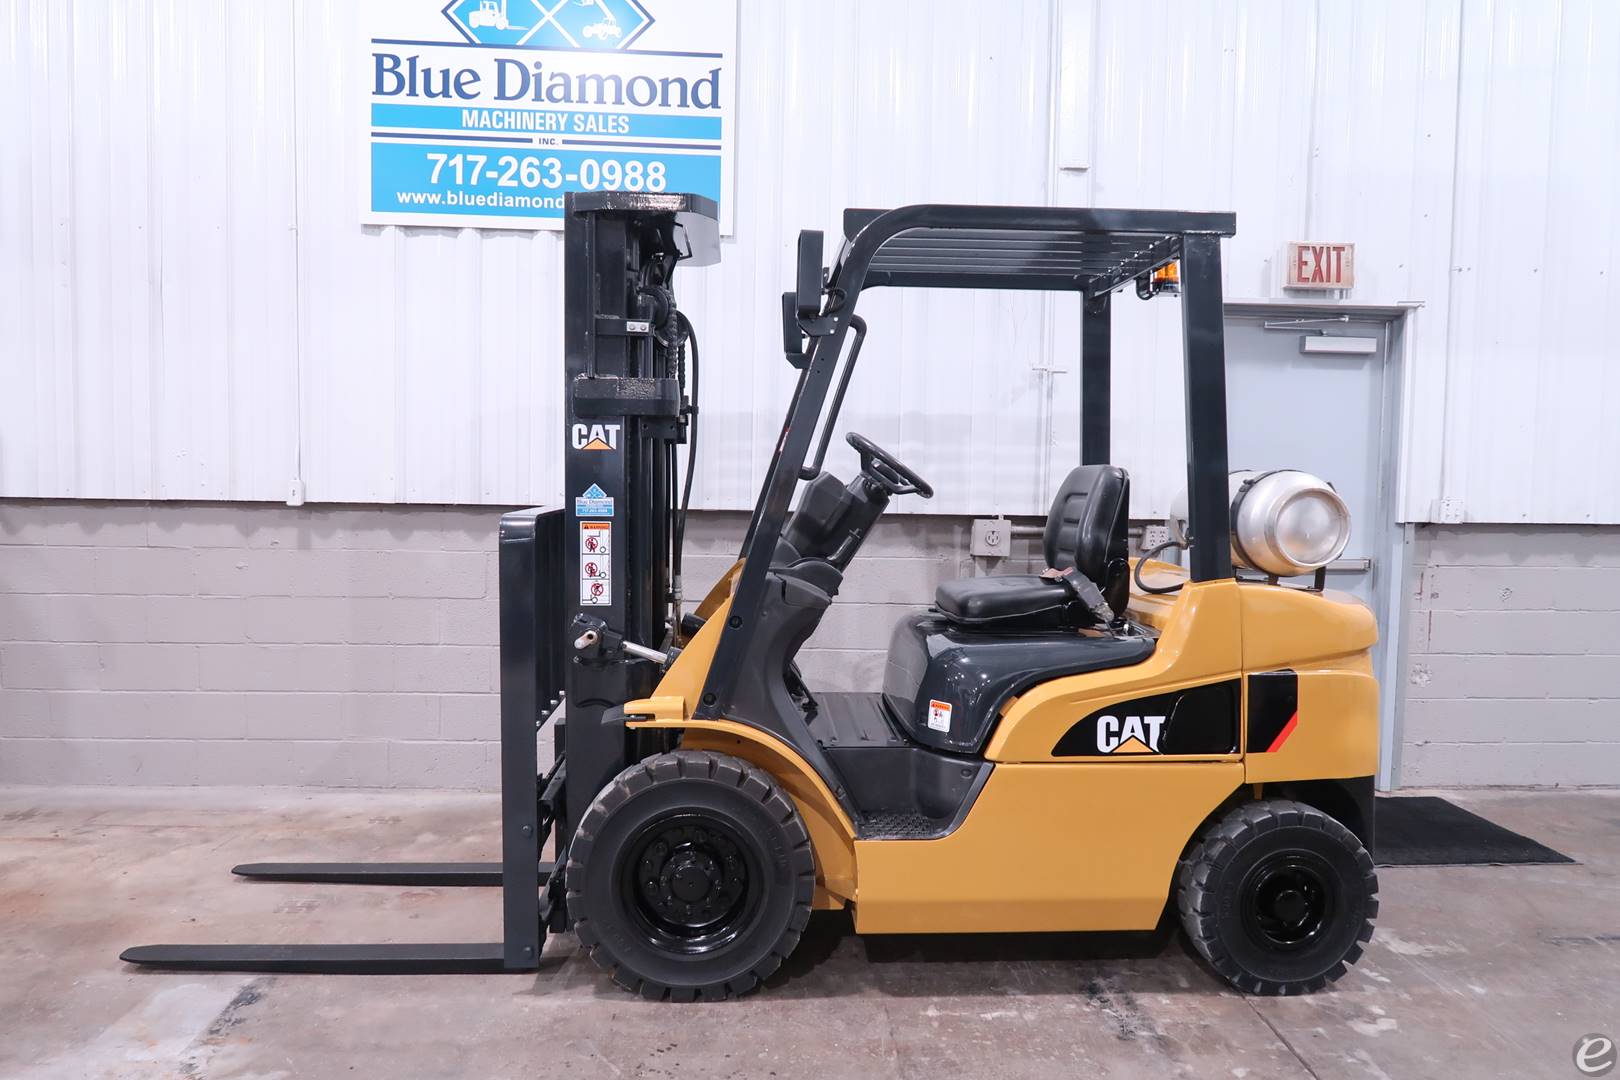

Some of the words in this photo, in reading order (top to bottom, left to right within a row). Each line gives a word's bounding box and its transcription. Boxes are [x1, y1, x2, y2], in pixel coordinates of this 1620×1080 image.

[372, 53, 481, 100] Blue
[494, 58, 722, 109] Diamond
[462, 109, 569, 132] MACHINERY
[573, 113, 630, 133] SALES
[538, 138, 559, 146] INC.
[426, 153, 667, 192] 717-263-0988
[1297, 246, 1345, 283] EXIT
[572, 424, 621, 450] CAT
[1096, 715, 1166, 753] CAT
